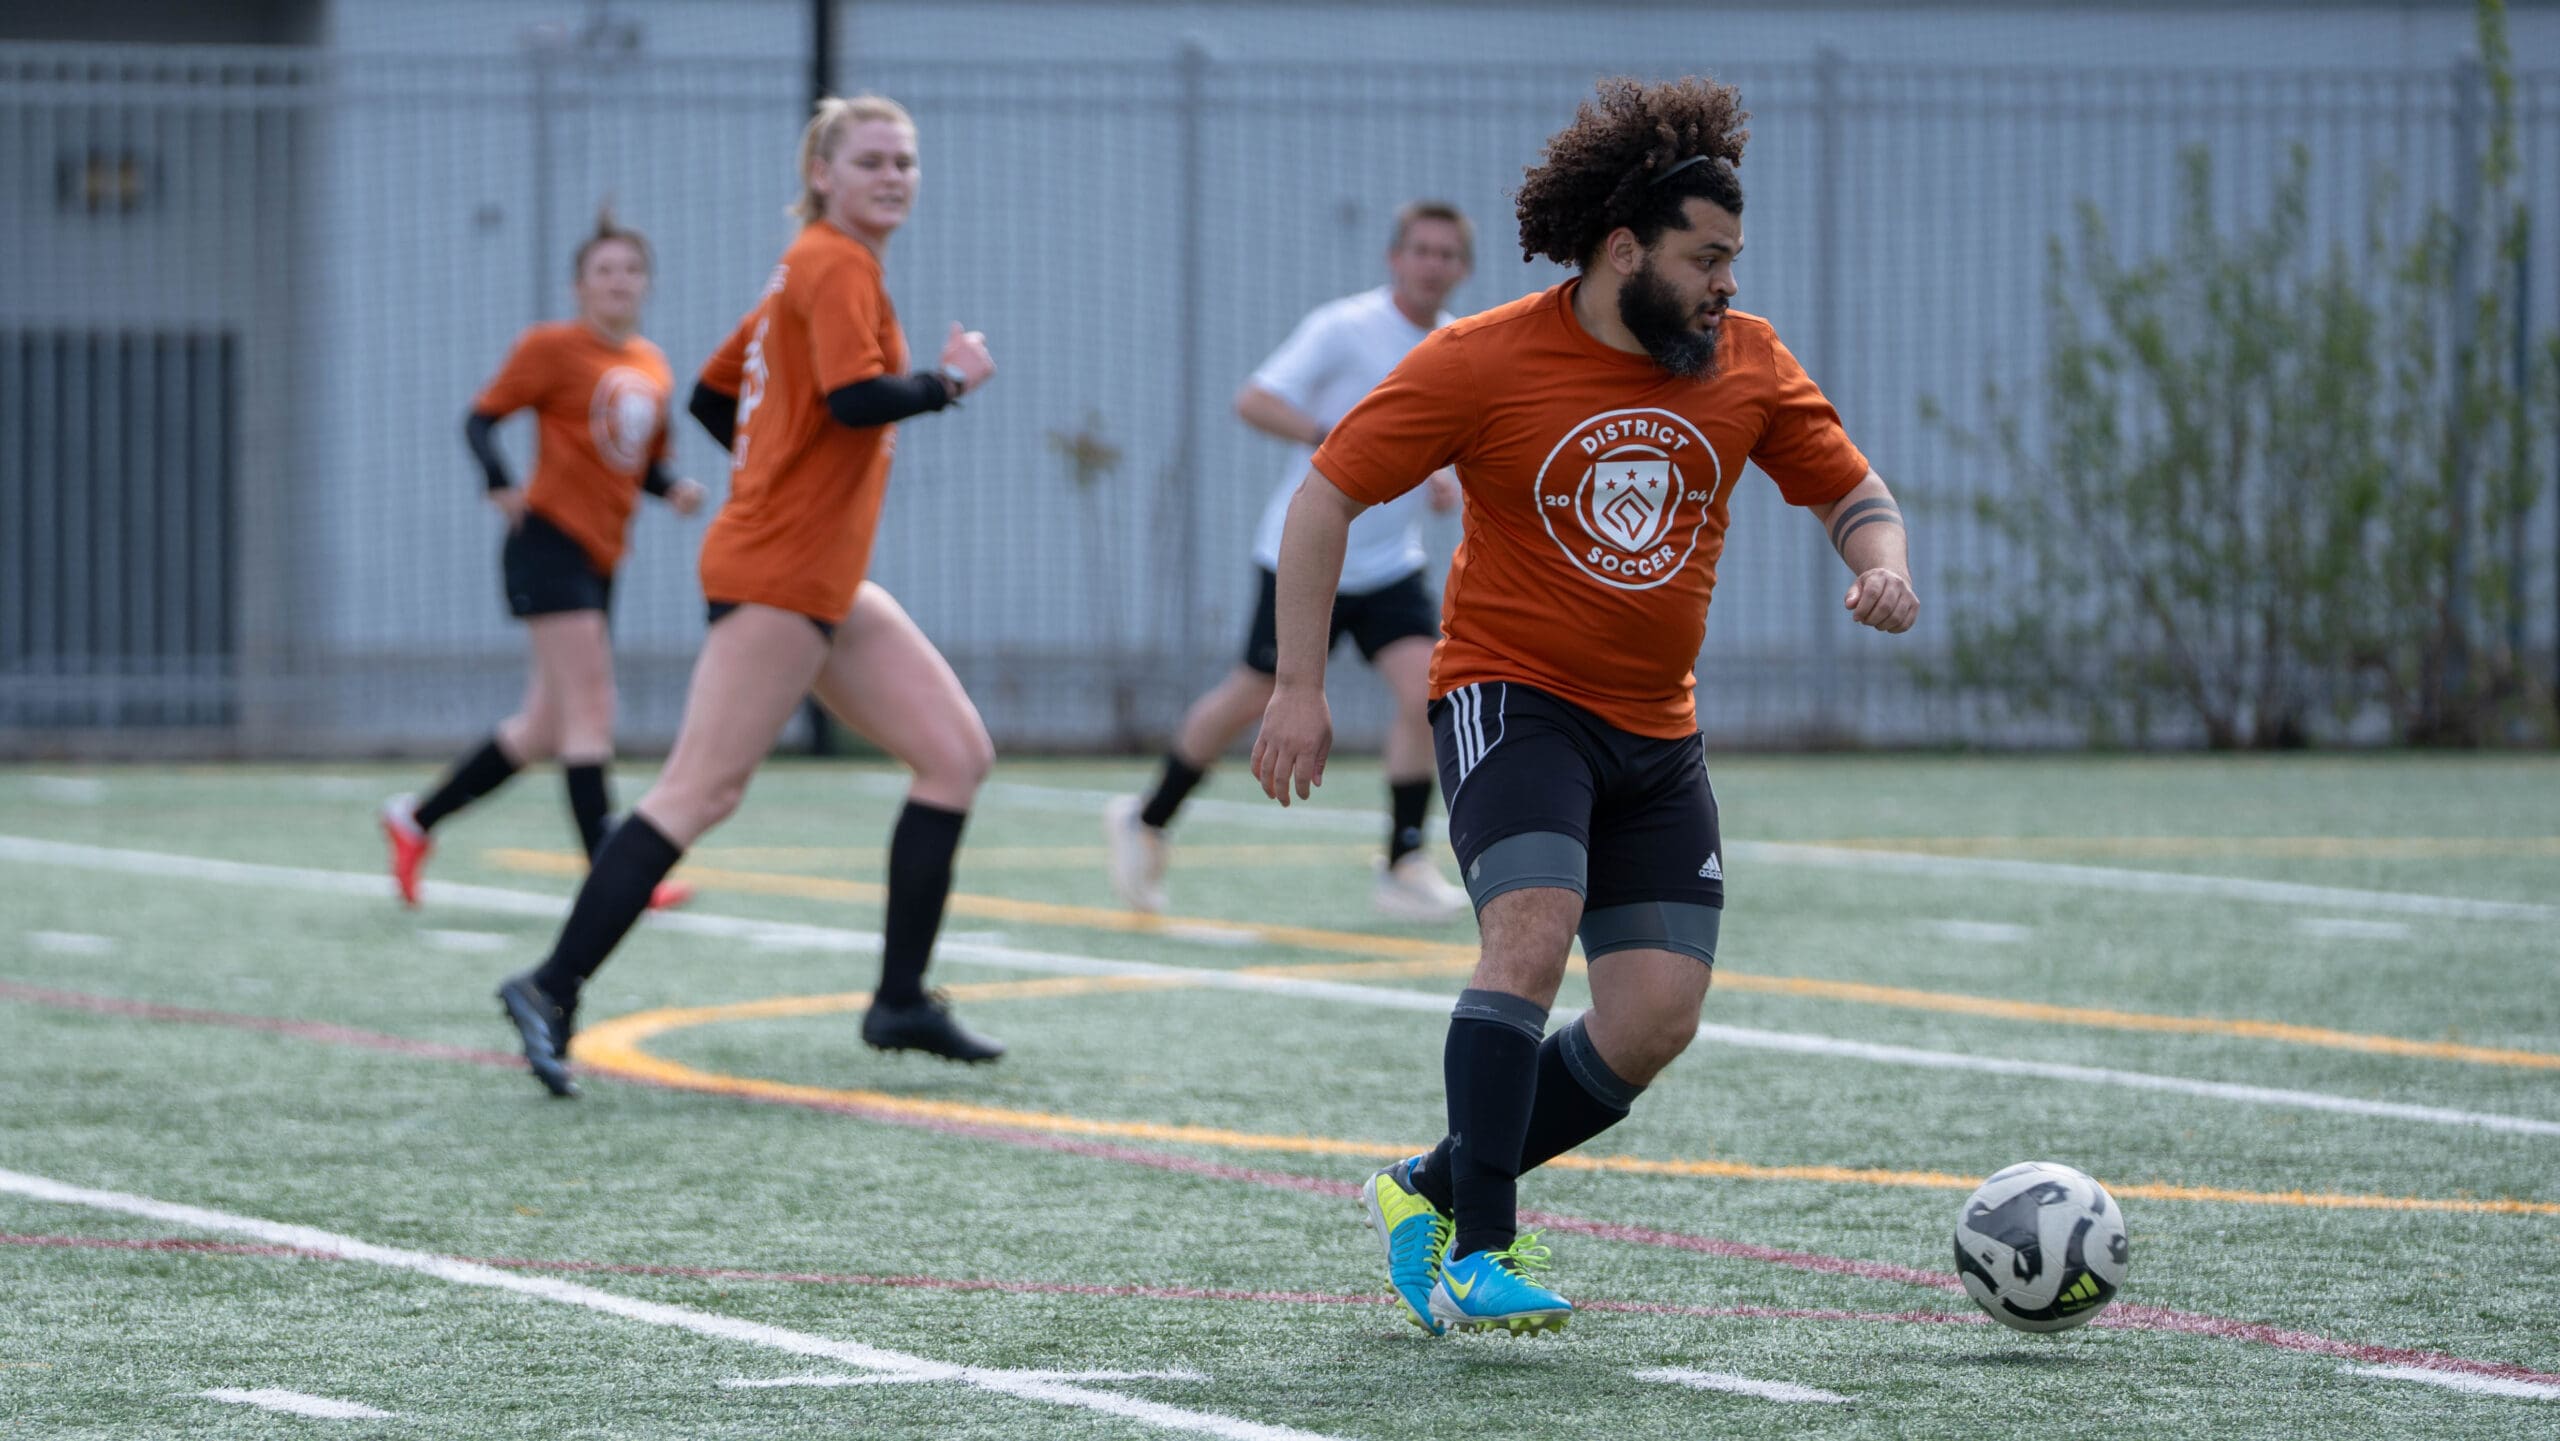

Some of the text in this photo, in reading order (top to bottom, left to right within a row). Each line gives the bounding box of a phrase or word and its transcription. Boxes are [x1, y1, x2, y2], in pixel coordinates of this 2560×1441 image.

[1580, 419, 1690, 455] DISTRICT
[1546, 490, 1707, 507] 20 04
[1586, 544, 1677, 576] SOCCER
